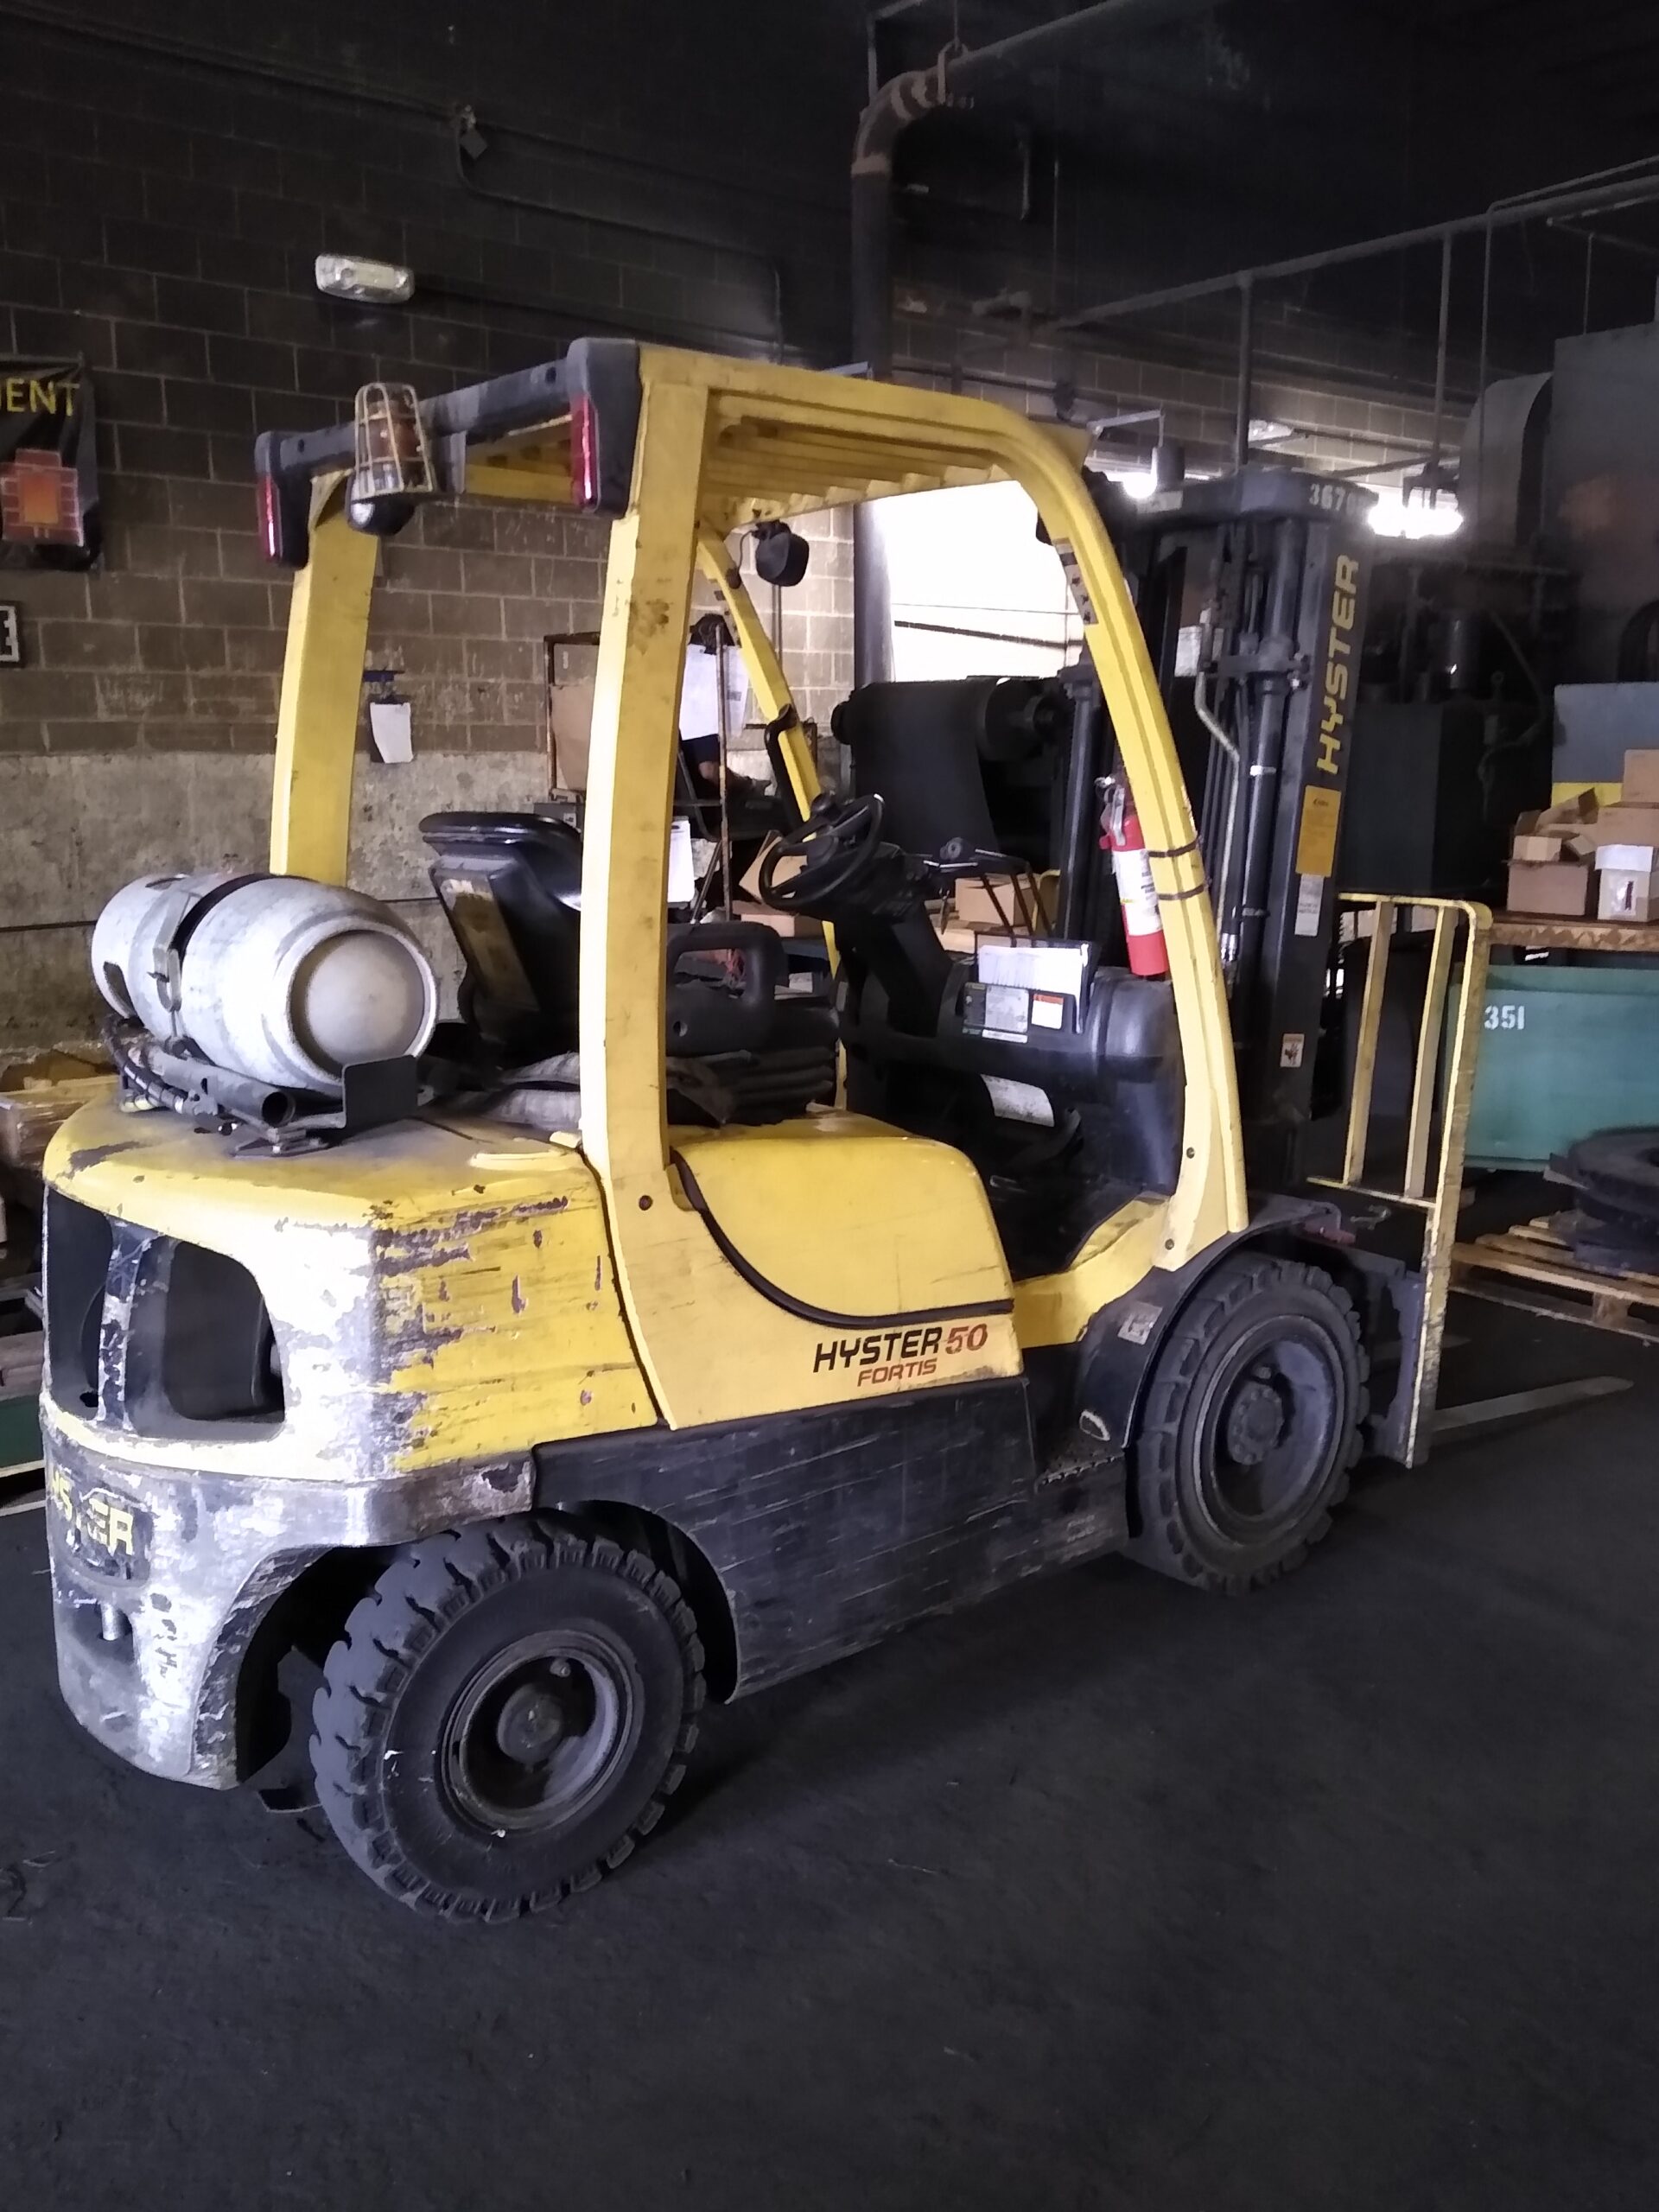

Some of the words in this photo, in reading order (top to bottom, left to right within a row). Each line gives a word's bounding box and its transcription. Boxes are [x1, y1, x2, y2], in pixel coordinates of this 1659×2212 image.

[0, 378, 80, 417] ENT
[1316, 555, 1359, 774] HYSTER
[1484, 1005, 1525, 1030] 351
[813, 1326, 943, 1373] HYSTER
[944, 1323, 988, 1355] 50
[857, 1357, 938, 1387] FORTIS
